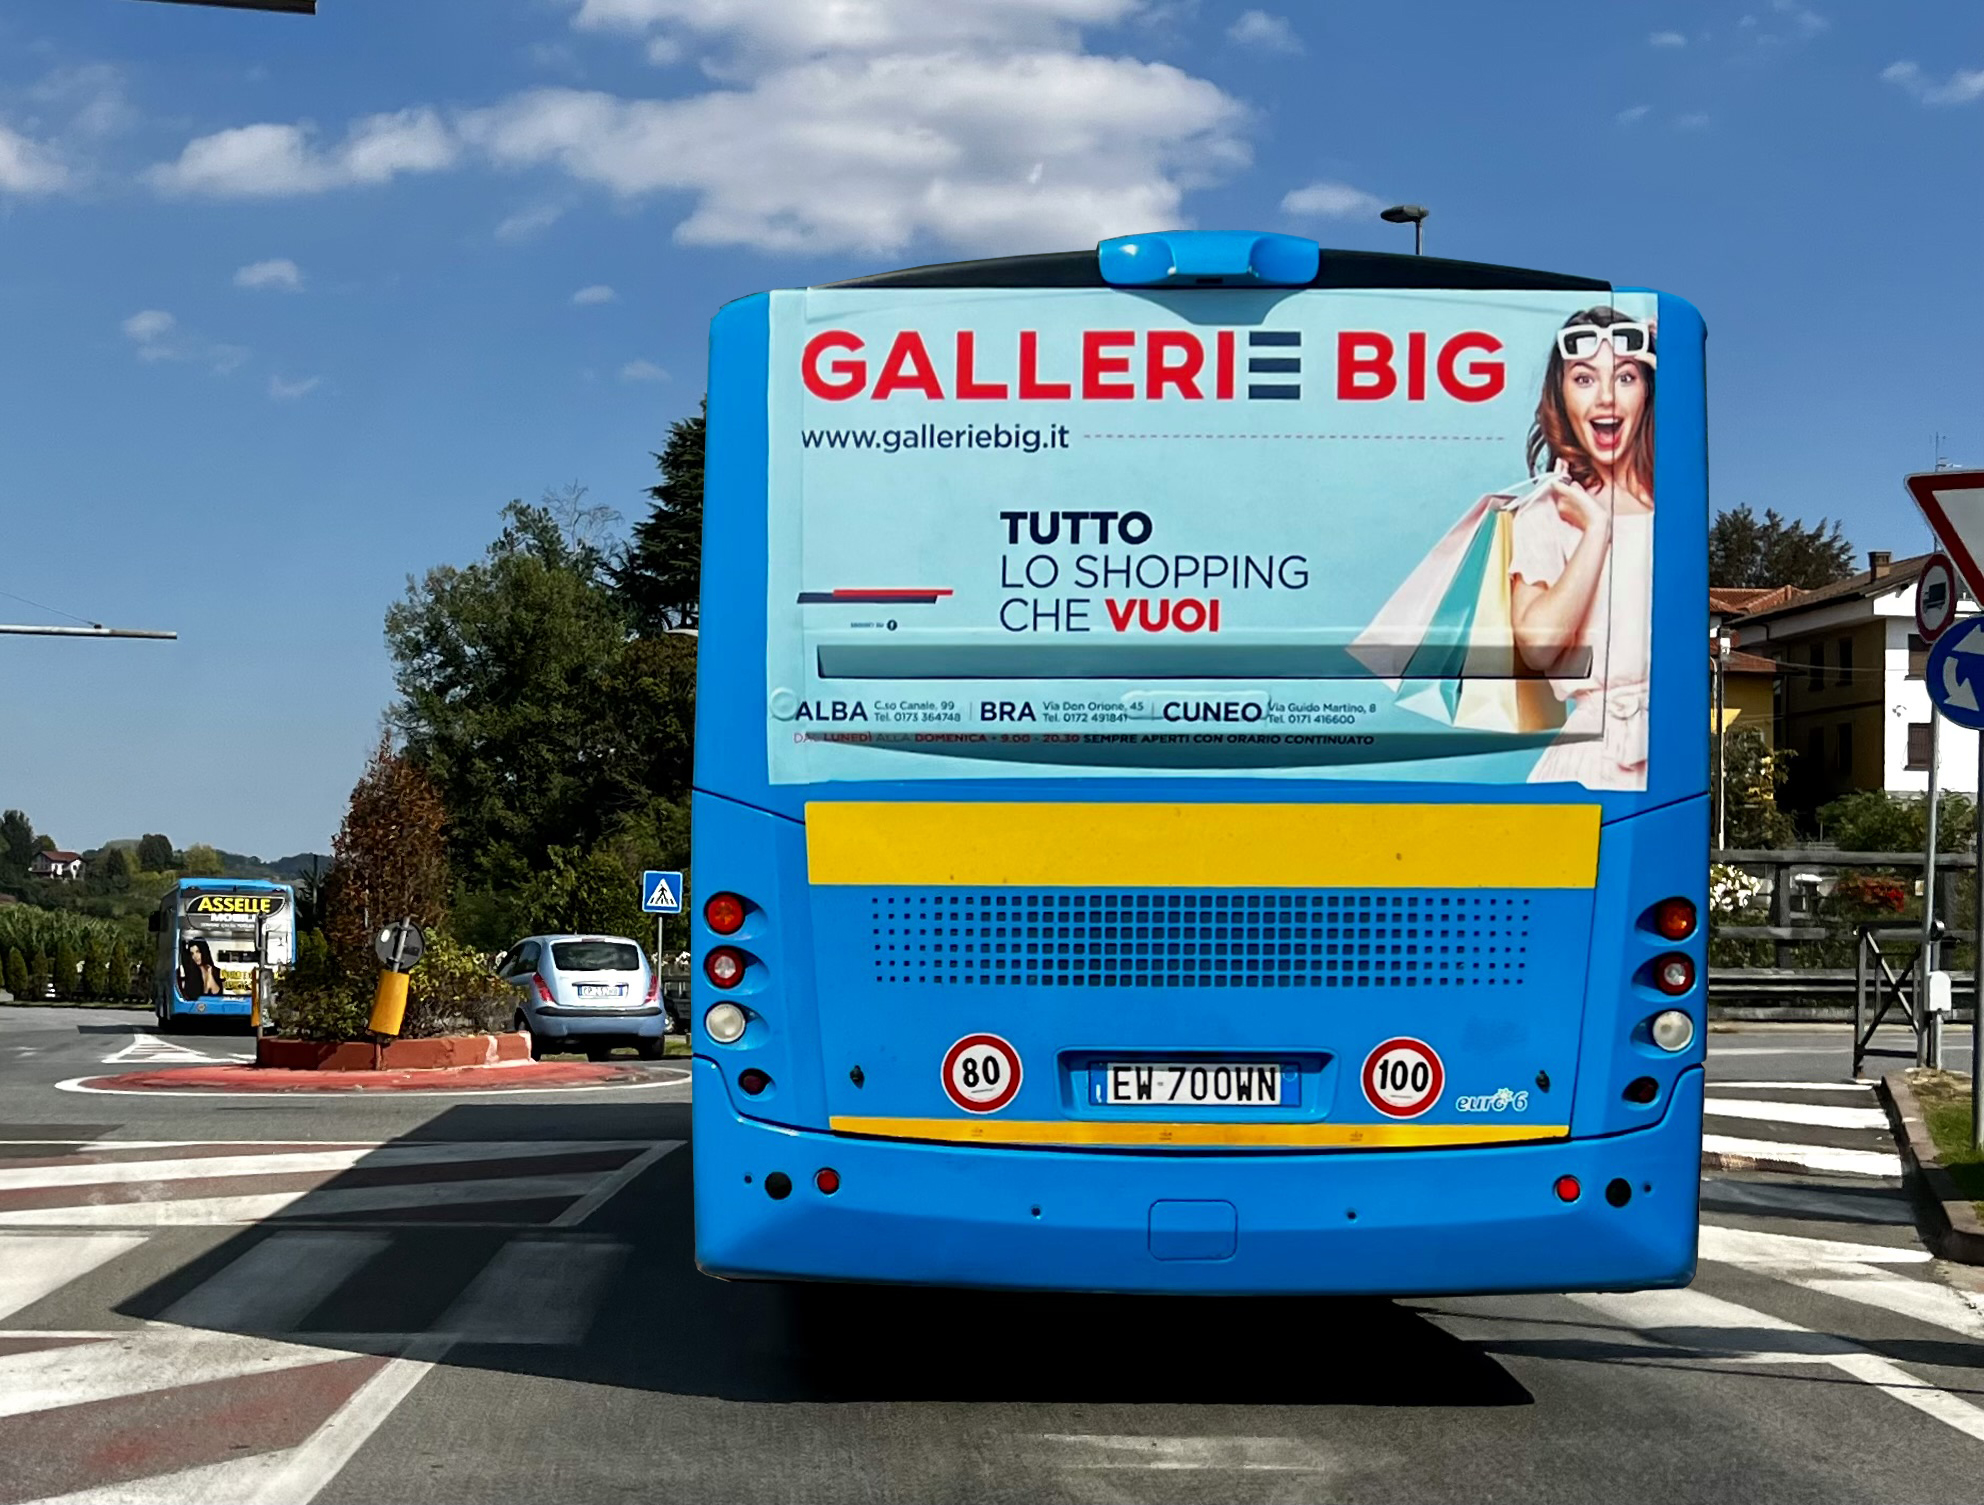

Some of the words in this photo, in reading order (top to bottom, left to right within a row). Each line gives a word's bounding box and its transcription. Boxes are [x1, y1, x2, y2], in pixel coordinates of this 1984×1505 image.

[801, 330, 1301, 402] GALLERIE
[1337, 331, 1506, 402] BIG
[801, 424, 1070, 453] www.galleriebig.it
[1000, 511, 1153, 545] TUTTO
[1001, 555, 1059, 589] LO
[1074, 555, 1310, 590] SHOPPING
[1000, 598, 1091, 632] CHE
[1105, 599, 1220, 633] VUOI
[796, 701, 868, 722] ALBA
[874, 701, 897, 711] C.so
[900, 701, 939, 712] Canale,
[941, 701, 955, 711] 99
[981, 702, 1036, 722] BRA
[1043, 702, 1061, 711] Via
[1063, 702, 1086, 711] Don
[1088, 702, 1128, 712] Orione,
[1130, 702, 1144, 711] 45
[1163, 702, 1262, 722] CUNEO
[1268, 702, 1286, 712] Via
[1288, 703, 1320, 713] Guido
[1323, 704, 1366, 715] Martino,
[1369, 704, 1376, 713] 8
[874, 712, 892, 723] Tel.
[894, 712, 919, 723] 0173
[921, 712, 962, 723] 364748
[1043, 713, 1061, 723] Tel.
[1064, 713, 1089, 723] 0172
[1288, 714, 1312, 724] 0171
[1314, 714, 1355, 725] 416600
[915, 732, 987, 743] DOMENICA
[1084, 734, 1137, 744] SEMPRE
[1141, 734, 1189, 744] APERTI
[1193, 734, 1223, 744] CON
[1227, 735, 1280, 744] ORARIO
[1285, 735, 1374, 745] CONTINUATO
[197, 897, 271, 913] ASSELLE
[962, 1056, 1000, 1088] 80
[1379, 1059, 1429, 1092] 100
[1113, 1066, 1153, 1101] EW
[1168, 1067, 1276, 1101] 700WN
[1513, 1091, 1529, 1112] 6
